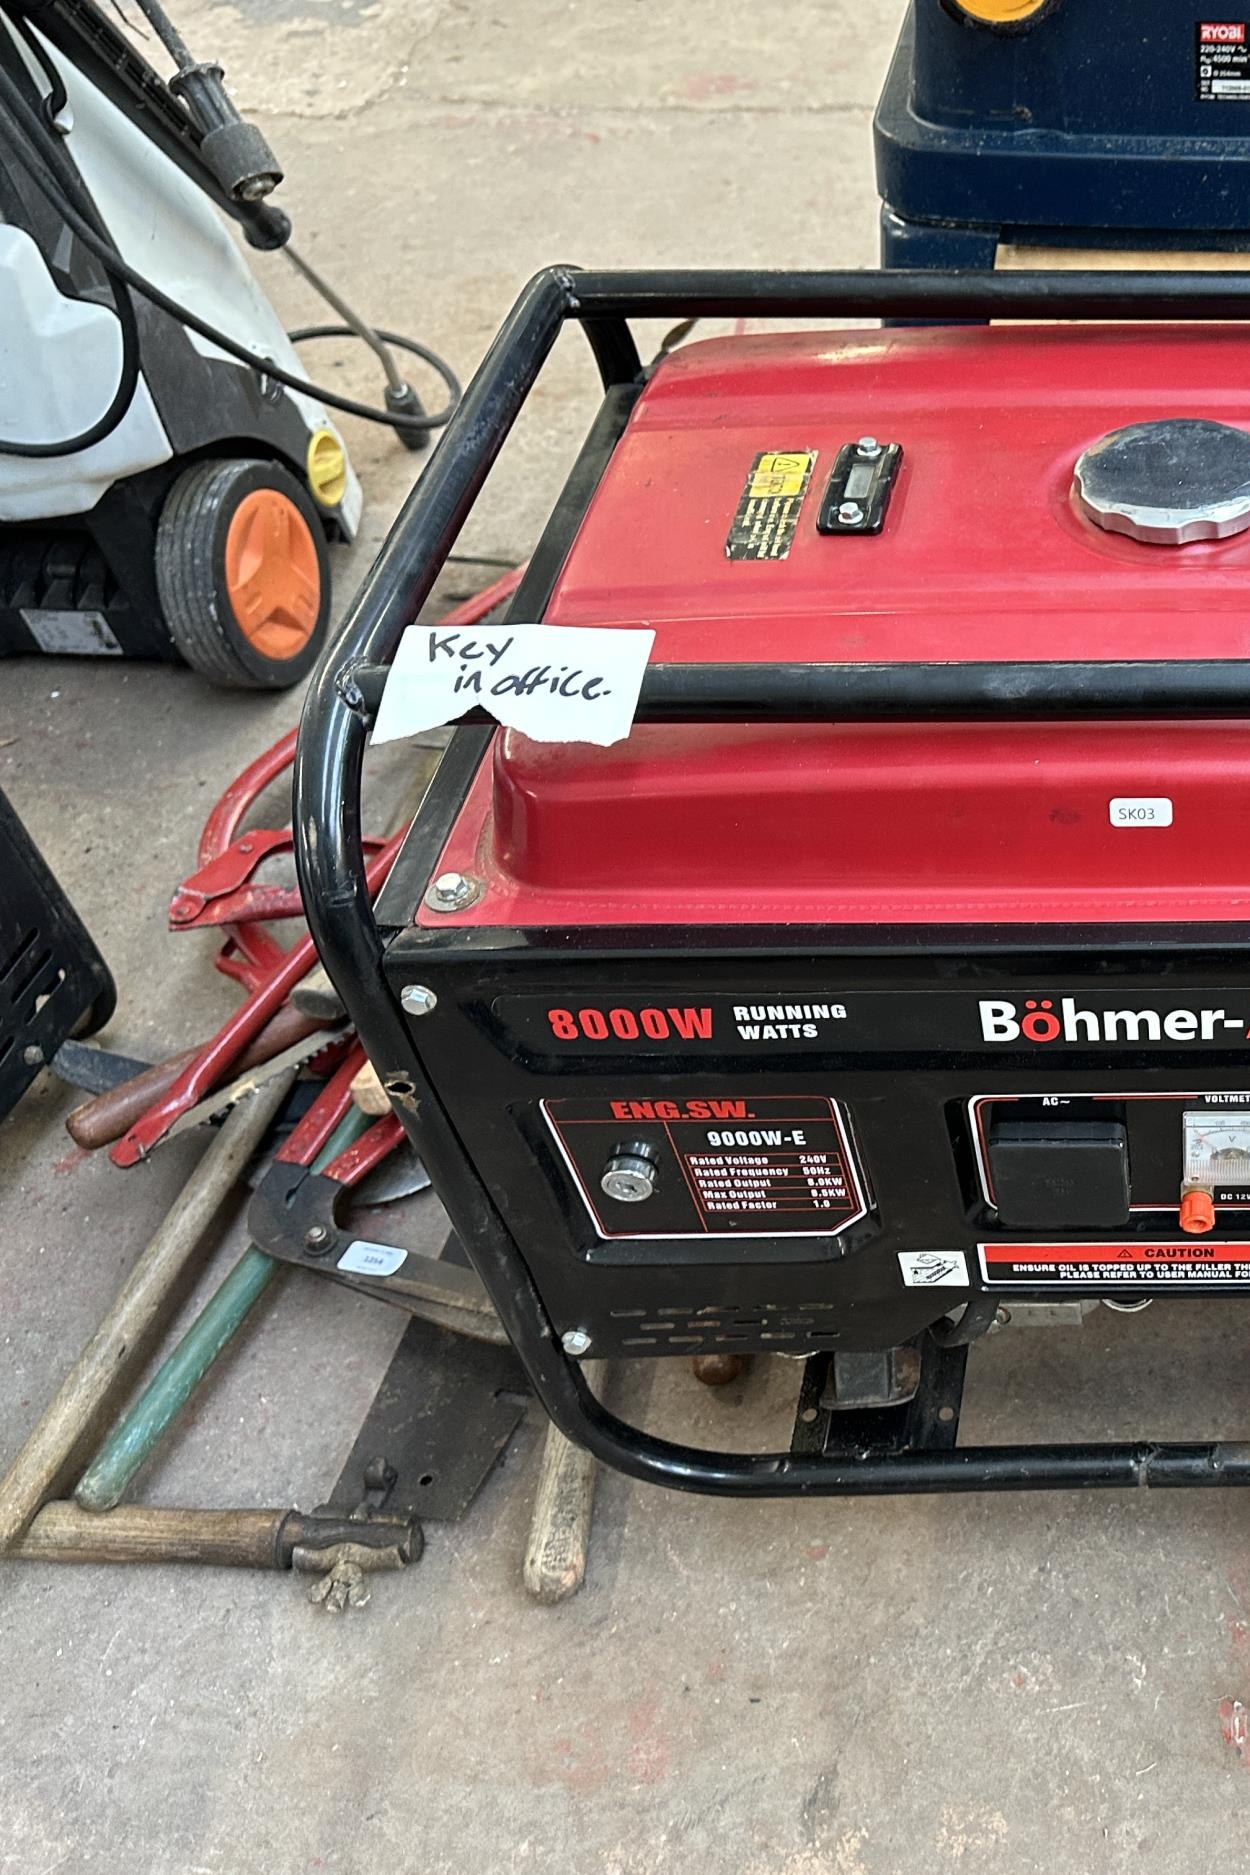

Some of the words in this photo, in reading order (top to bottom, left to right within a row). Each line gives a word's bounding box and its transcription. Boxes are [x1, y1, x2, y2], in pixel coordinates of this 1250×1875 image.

[1201, 24, 1243, 39] RYOBI
[454, 664, 482, 693] in
[1118, 808, 1155, 820] SK03
[733, 1004, 847, 1022] RUNNING
[547, 1007, 713, 1040] 8000W
[737, 1023, 819, 1041] WATTS
[609, 1100, 756, 1119] ENG.SW.
[707, 1130, 807, 1147] 9000W-E
[689, 1156, 724, 1165] Rated
[725, 1156, 769, 1165] Voltage
[799, 1155, 827, 1164] 240V
[694, 1168, 728, 1177] Rated
[730, 1167, 789, 1177] Frequency
[802, 1166, 831, 1175] 50Hz
[698, 1179, 732, 1188] Rated
[734, 1179, 771, 1188] Output
[703, 1190, 728, 1199] Max
[729, 1189, 767, 1199] Output
[707, 1201, 740, 1210] Rated
[741, 1200, 777, 1210] Factor
[813, 1200, 831, 1208] 1.0
[1144, 1248, 1215, 1258] CAUTION
[1012, 1264, 1056, 1272] ENSURE
[1058, 1264, 1077, 1272] OIL
[1078, 1264, 1090, 1272] IS
[1092, 1264, 1135, 1272] TOPPED
[1196, 1263, 1232, 1271] FILLER
[1060, 1271, 1100, 1279] PLEASE
[1103, 1271, 1137, 1279] REFER
[1139, 1271, 1154, 1279] TO
[1157, 1271, 1185, 1279] USER
